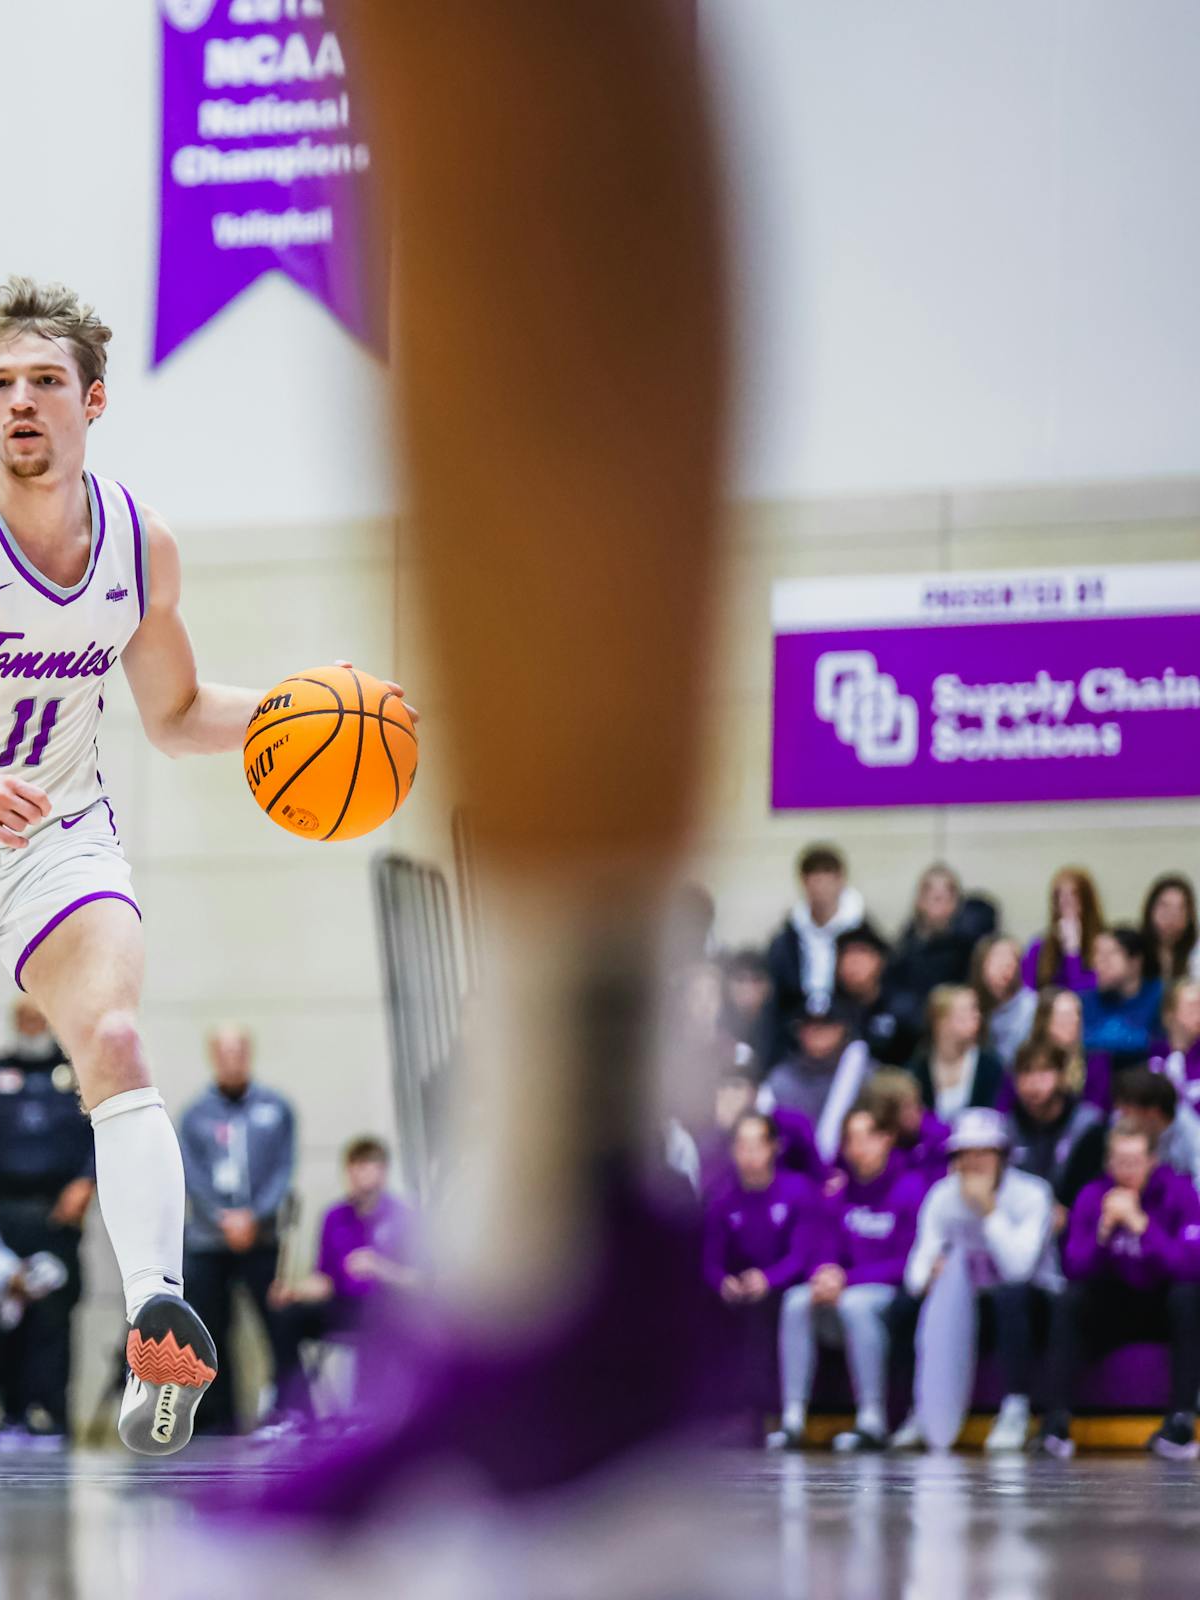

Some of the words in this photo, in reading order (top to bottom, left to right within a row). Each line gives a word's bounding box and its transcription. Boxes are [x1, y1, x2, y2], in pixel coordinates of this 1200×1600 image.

[204, 33, 346, 88] NCAA
[198, 92, 349, 138] National
[932, 669, 1075, 722] Supply
[930, 721, 1121, 762] Solutions
